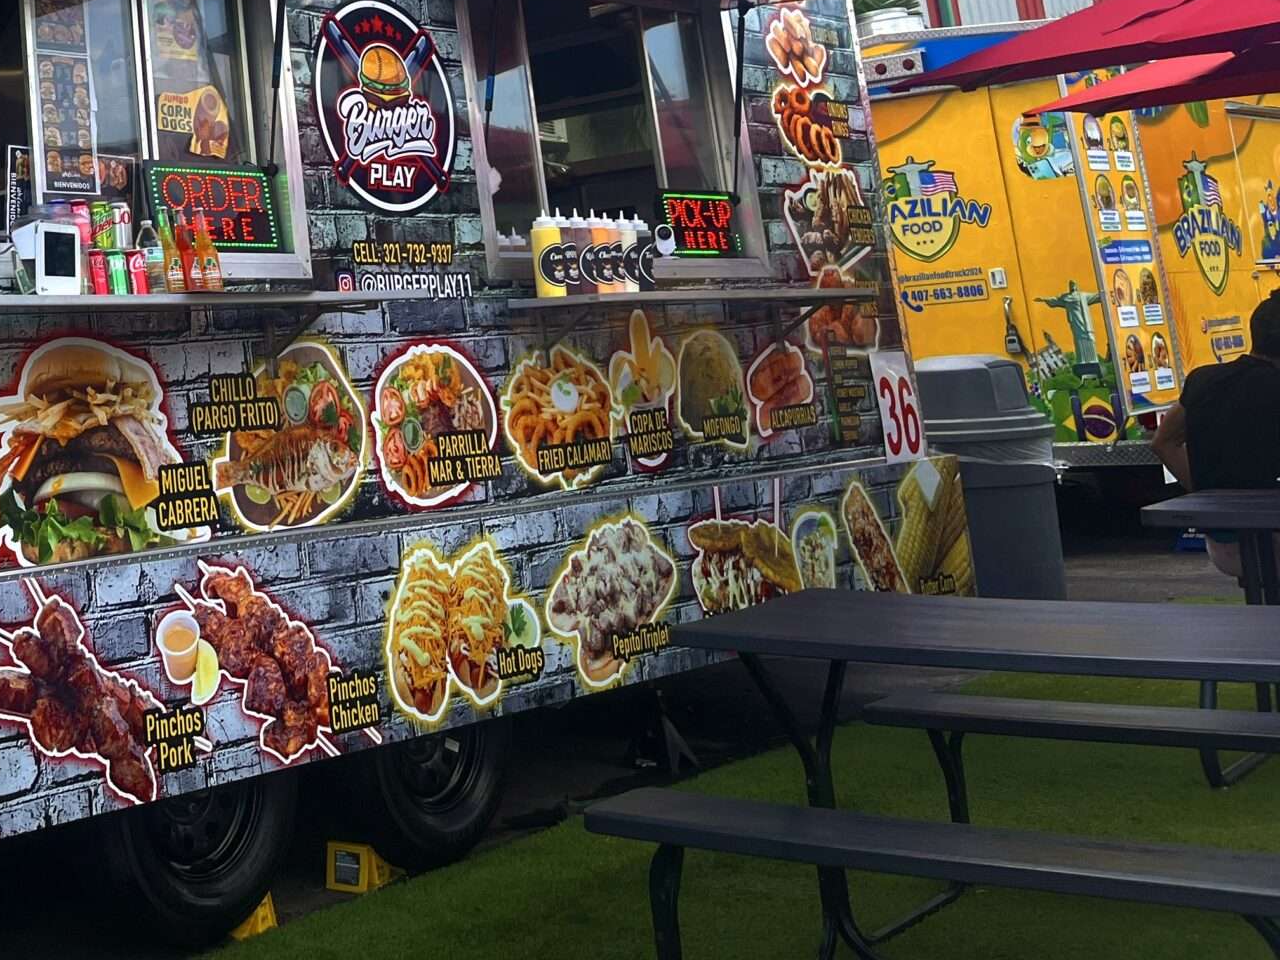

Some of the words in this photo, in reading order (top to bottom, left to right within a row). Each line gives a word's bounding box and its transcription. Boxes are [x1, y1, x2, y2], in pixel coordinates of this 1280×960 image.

[160, 103, 192, 119] CORN
[163, 94, 189, 104] JUMBO
[162, 118, 193, 132] DOGS
[338, 93, 436, 160] Burger
[370, 166, 415, 188] PLAY
[162, 174, 264, 213] ORDER
[668, 200, 731, 227] PICK-UP
[889, 198, 991, 226] AZILIAN
[684, 232, 728, 249] HERE
[902, 221, 943, 236] FOOD
[1174, 208, 1242, 257] BRAZILIAN
[354, 242, 381, 263] CELL:
[383, 243, 452, 264] 321-732-9337
[1200, 241, 1221, 256] FOOD
[911, 284, 984, 302] 407-663-8806
[210, 376, 255, 402] CHILLO
[192, 401, 238, 432] (PARGO
[240, 399, 279, 429] FRITO)
[632, 413, 653, 433] COPA
[655, 411, 667, 430] DE
[703, 416, 742, 438] MOFONGO
[771, 405, 817, 428] ALCAPURRIAS
[880, 376, 920, 456] 36
[438, 433, 488, 456] PARRILLA
[538, 446, 563, 471] FRIED
[564, 441, 612, 468] CALAMARI
[630, 430, 674, 455] MARISCOS
[161, 468, 210, 495] MIGUEL
[430, 461, 455, 484] MAR
[456, 461, 467, 481] &
[467, 456, 502, 480] TIERRA
[158, 495, 218, 527] CABRERA
[499, 652, 516, 676] Hot
[517, 648, 543, 674] Dogs
[329, 674, 377, 703] Pinchos
[146, 709, 202, 739] Pinchos
[331, 702, 380, 731] Chicken
[160, 742, 194, 769] Pork
